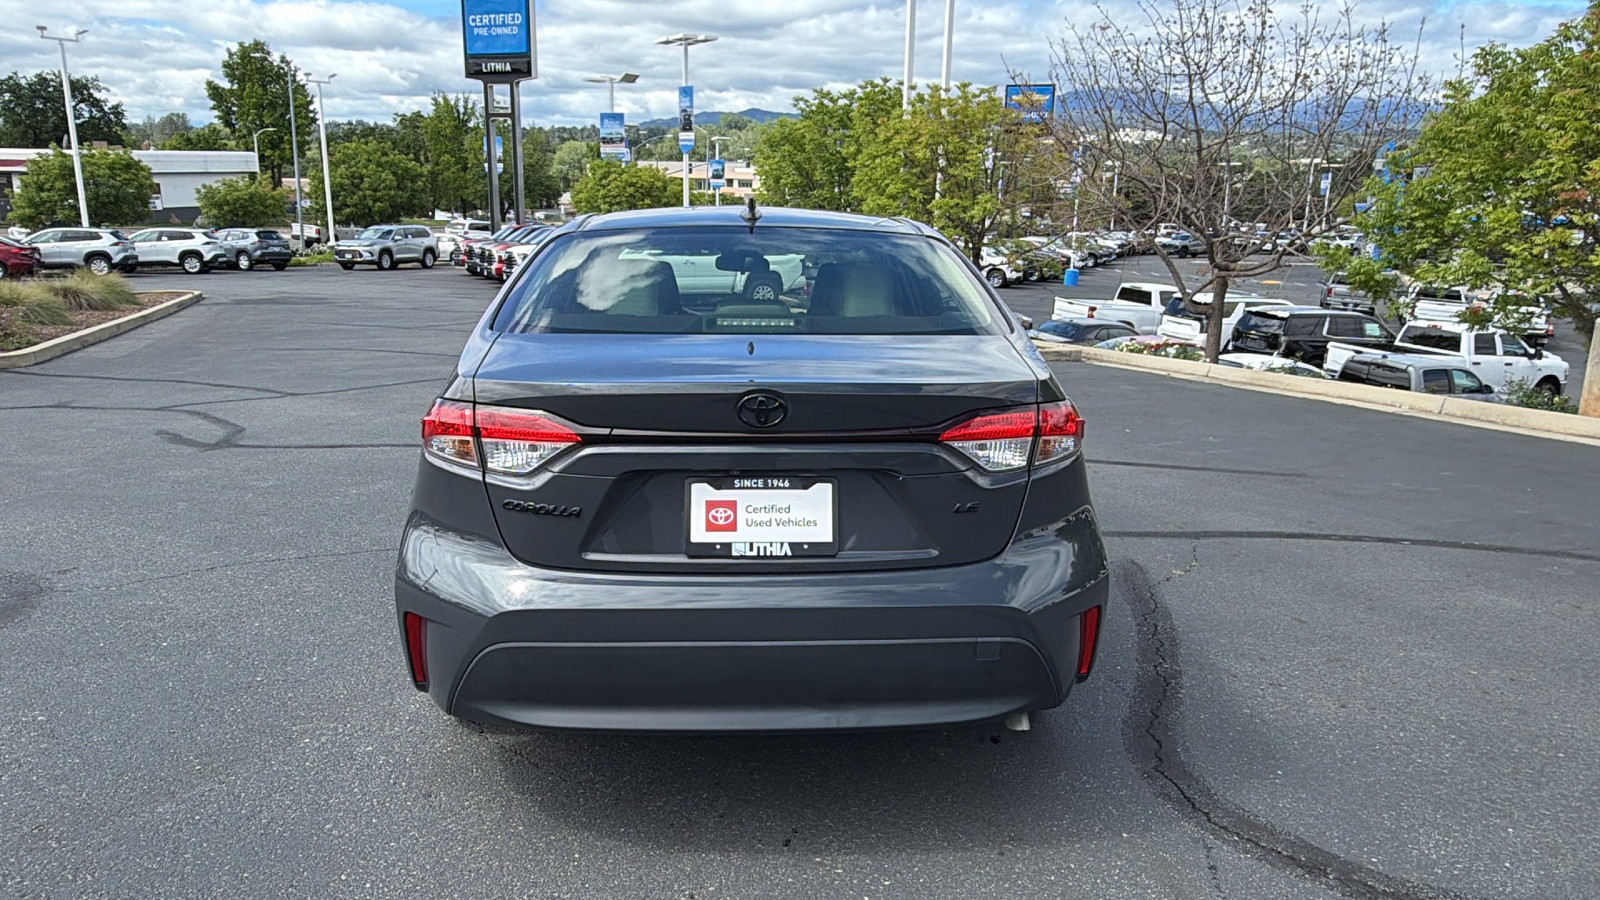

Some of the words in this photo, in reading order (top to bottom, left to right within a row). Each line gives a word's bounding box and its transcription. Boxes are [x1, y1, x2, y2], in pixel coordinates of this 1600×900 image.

[469, 13, 522, 26] CERTIFIED
[474, 26, 518, 36] PRE-OWNED
[482, 62, 512, 72] LITHIA
[734, 479, 764, 488] SINCE
[768, 479, 790, 488] 1946
[502, 499, 582, 518] COROLLA
[745, 504, 791, 514] Certified
[953, 501, 980, 514] LE
[745, 518, 772, 527] Used
[774, 518, 818, 527] Vehicles
